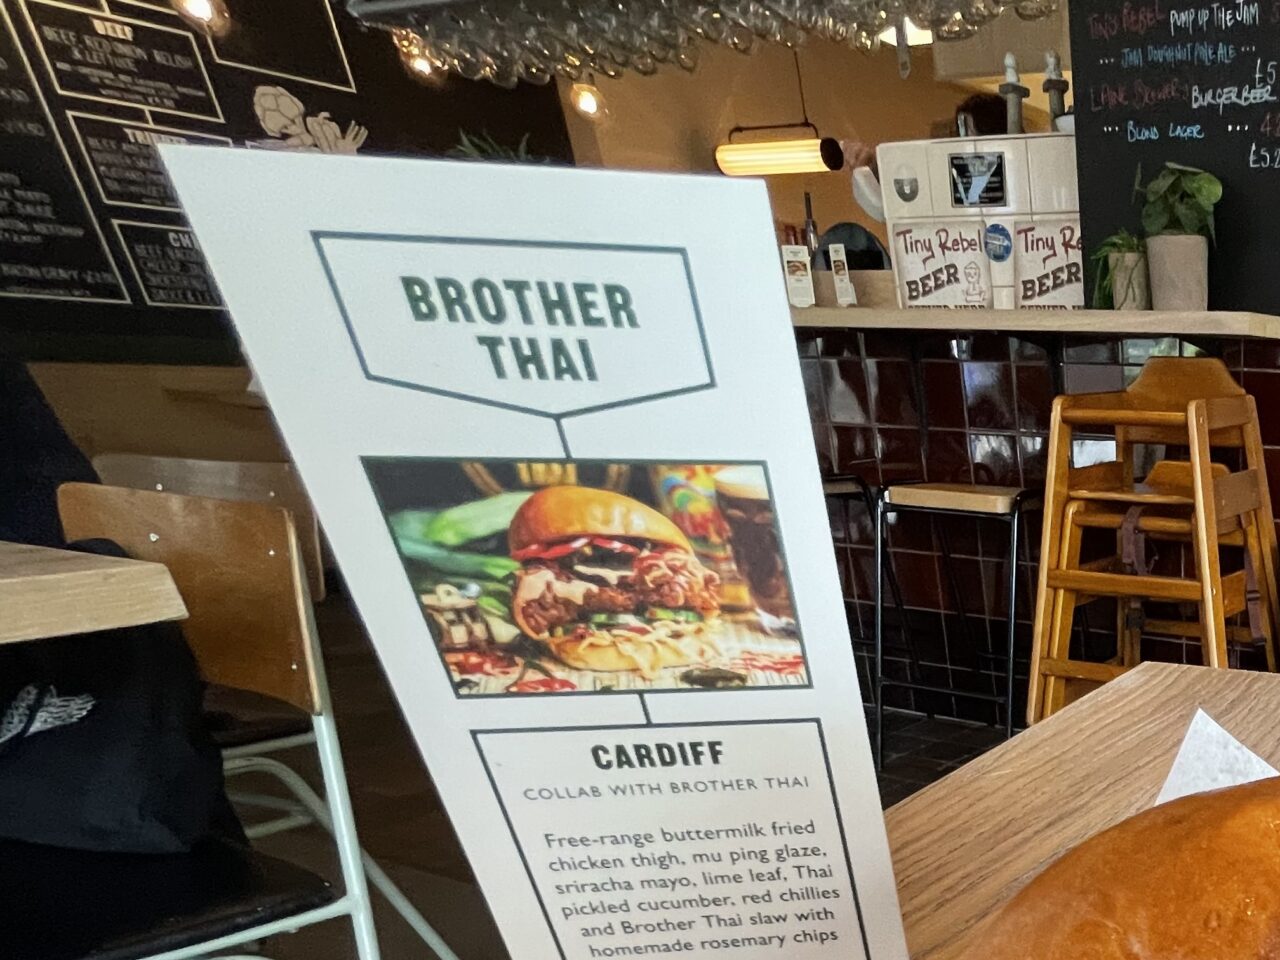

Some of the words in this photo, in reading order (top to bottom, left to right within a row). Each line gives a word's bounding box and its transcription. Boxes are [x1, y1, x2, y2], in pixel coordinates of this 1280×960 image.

[1170, 9, 1194, 36] PUMP
[1197, 8, 1210, 32] UP
[1211, 2, 1233, 28] THE
[1235, 0, 1259, 27] JAM
[895, 228, 935, 271] Tiny
[936, 228, 983, 261] Rebel
[1017, 227, 1057, 270] Tiny
[906, 263, 961, 301] BEER
[1022, 261, 1082, 300] BEER
[398, 275, 641, 329] BROTHER
[474, 334, 599, 382] THAI
[590, 740, 724, 771] CARDIFF
[522, 785, 603, 801] COLLAB
[607, 782, 663, 796] WITH
[669, 778, 758, 794] BROTHER
[763, 775, 809, 789] THAI
[543, 832, 656, 849] Free-range
[660, 822, 768, 843] buttermilk
[770, 818, 816, 837] fried
[548, 854, 625, 873] chicken
[630, 850, 687, 871] thigh,
[691, 851, 723, 864] mu
[728, 847, 771, 866] ping
[774, 843, 828, 863] glaze,
[554, 876, 635, 895] sriracha
[639, 876, 698, 892] mayo,
[701, 871, 744, 886] lime
[748, 866, 788, 883] leaf,
[791, 863, 834, 880] Thai
[560, 898, 631, 921] pickled
[636, 893, 737, 912] cucumber,
[741, 888, 774, 905] red
[778, 886, 841, 903] chillies
[580, 921, 616, 938] and
[619, 917, 697, 935] Brother
[699, 913, 743, 929] Thai
[749, 911, 788, 926] slaw
[793, 906, 836, 923] with
[588, 938, 695, 958] homemade
[699, 934, 786, 950] rosemary
[792, 929, 839, 946] chips
